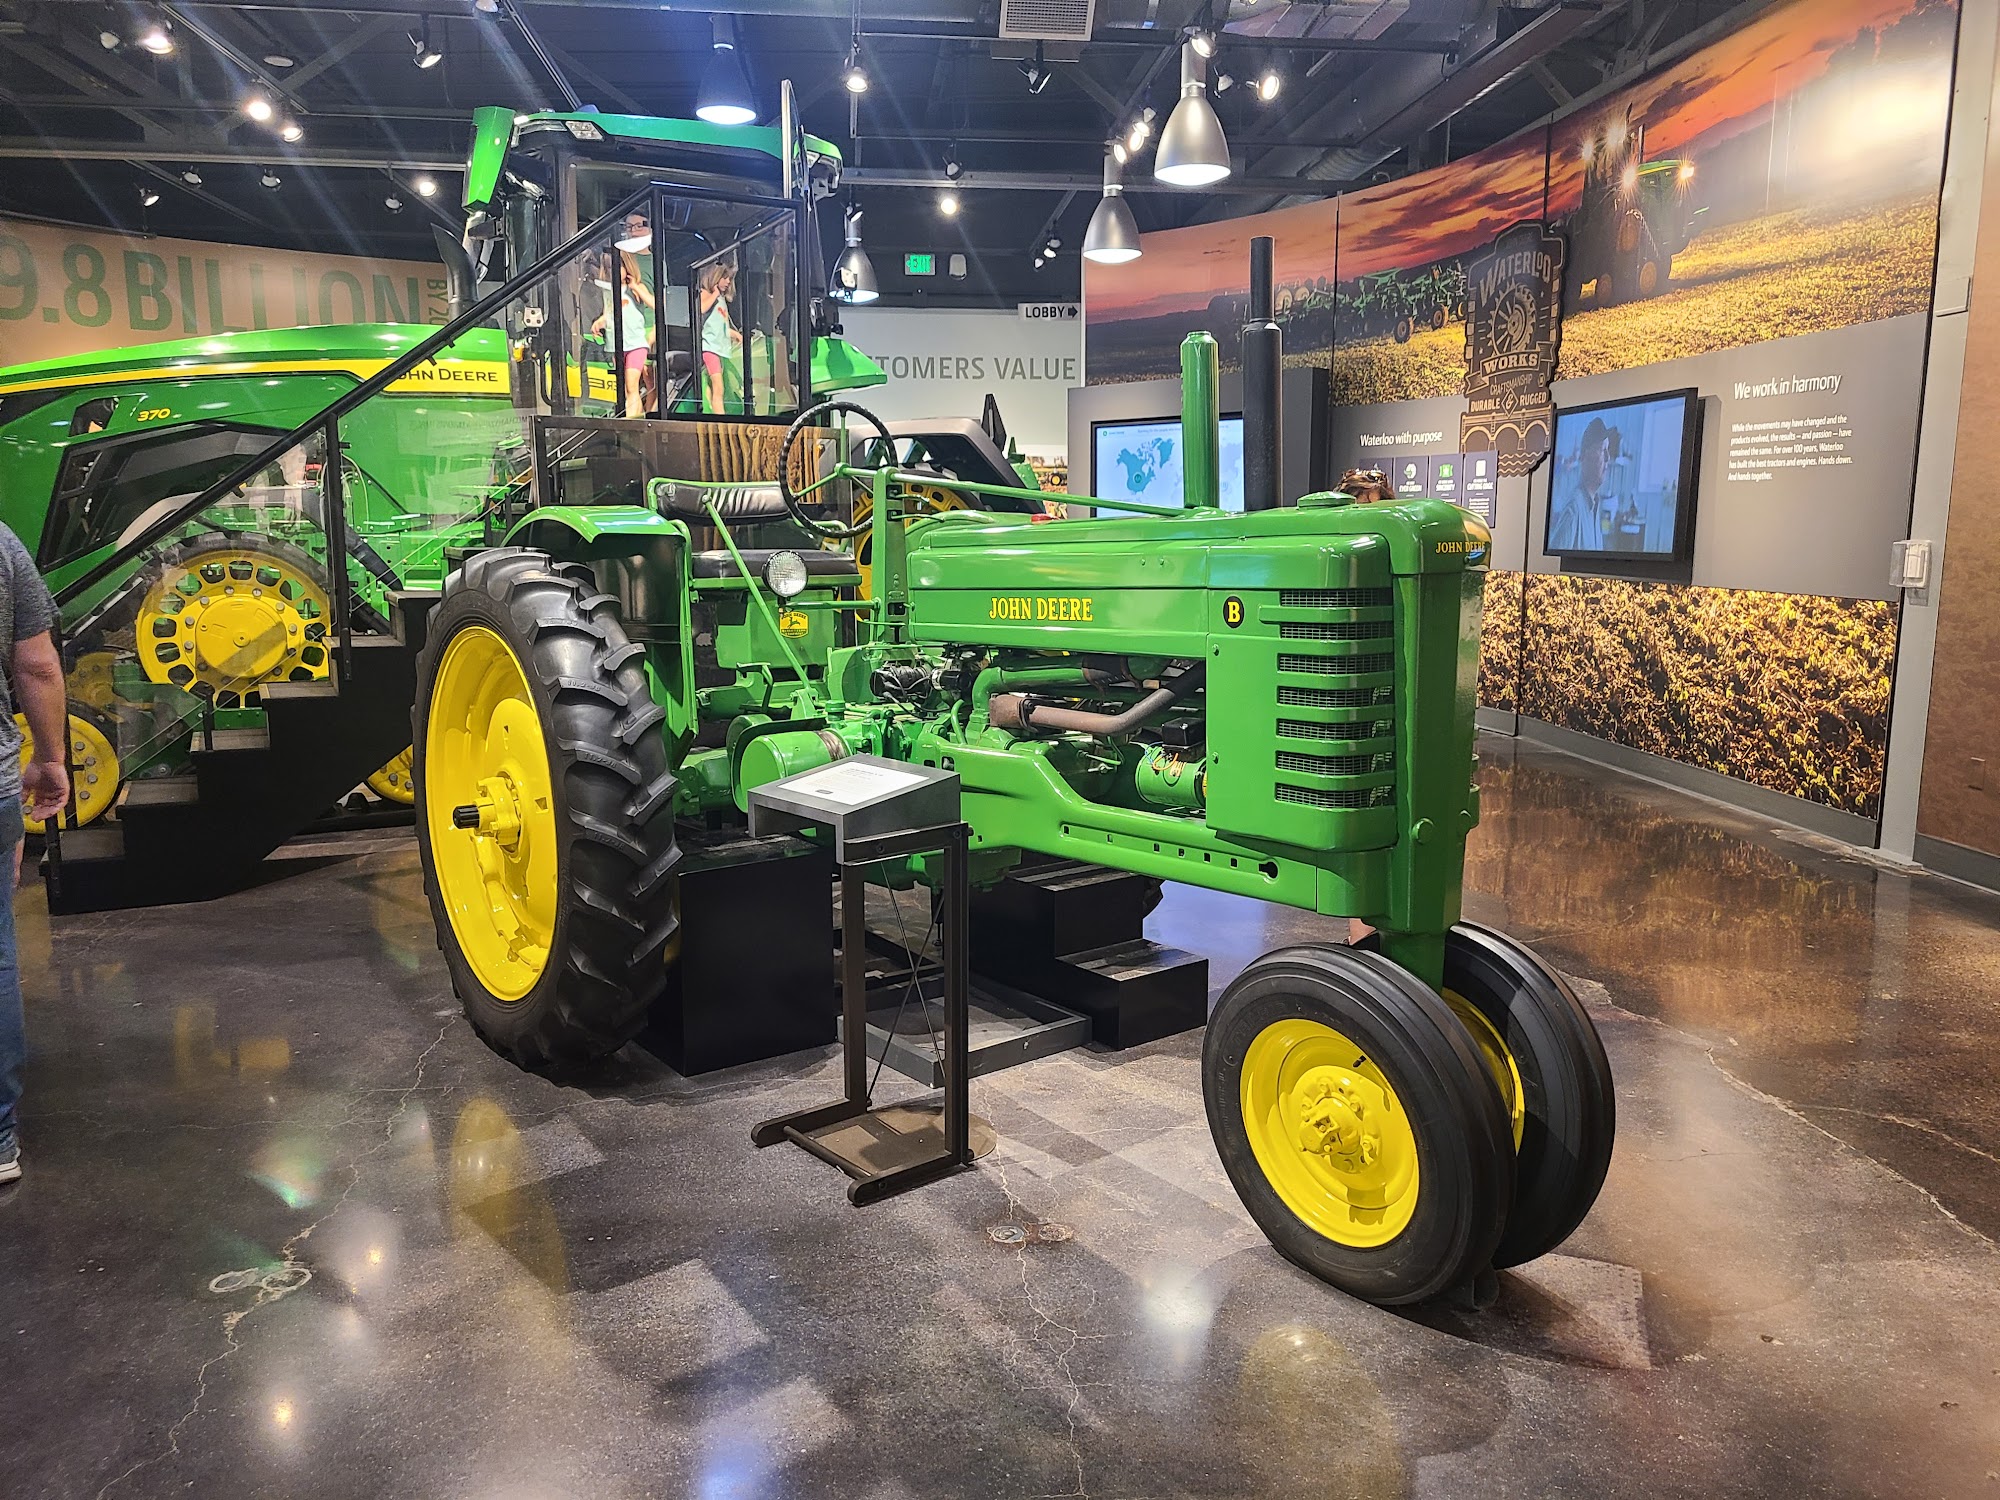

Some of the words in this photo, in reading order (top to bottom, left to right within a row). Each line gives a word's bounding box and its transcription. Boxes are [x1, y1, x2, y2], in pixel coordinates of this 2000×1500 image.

[909, 254, 932, 273] EXIT
[1480, 251, 1551, 308] WATERLOO
[123, 249, 421, 335] BILLION
[427, 278, 449, 304] BY
[1025, 306, 1065, 318] LOBBY
[867, 355, 985, 380] TOMERS
[993, 356, 1076, 381] VALUE
[1482, 353, 1539, 375] WORKS
[398, 368, 434, 381] OHN
[439, 368, 499, 382] DEERE
[1490, 373, 1533, 396] CRAFTSMANSHIP
[1734, 381, 1751, 400] We
[1752, 377, 1778, 398] work
[1779, 377, 1790, 395] in
[1791, 374, 1842, 395] harmony
[1470, 397, 1501, 413] DURABLE
[1520, 391, 1547, 407] RUGGED
[136, 407, 171, 422] 370
[1731, 423, 1744, 432] While
[1745, 422, 1753, 431] the
[1753, 420, 1780, 430] movements
[1780, 420, 1791, 430] may
[1792, 418, 1804, 428] have
[1804, 416, 1826, 428] changed
[1826, 414, 1838, 424] and
[1838, 414, 1848, 424] the
[1360, 432, 1394, 447] Waterloo
[1395, 430, 1412, 444] with
[1412, 430, 1443, 446] purpose
[1730, 436, 1750, 446] products
[1770, 432, 1779, 442] the
[1779, 432, 1796, 442] results
[1802, 430, 1812, 440] and
[1812, 430, 1832, 442] passion
[1838, 428, 1852, 438] have
[1730, 447, 1750, 456] remained
[1750, 446, 1758, 456] the
[1773, 445, 1782, 454] For
[1782, 446, 1794, 454] over
[1794, 444, 1803, 454] 100
[1818, 442, 1844, 452] Waterloo
[1728, 460, 1736, 468] has
[1736, 459, 1748, 468] built
[1748, 458, 1756, 468] the
[1756, 458, 1766, 468] best
[1766, 458, 1786, 468] tractors
[1786, 456, 1796, 466] and
[1796, 456, 1818, 468] engines.
[1818, 455, 1836, 466] Hands
[1836, 454, 1853, 465] down.
[1728, 472, 1738, 480] And
[1738, 471, 1750, 480] hands
[1750, 470, 1773, 482] together.
[1436, 542, 1463, 554] JOHN
[1465, 541, 1486, 553] DEERE
[989, 597, 1032, 620] JOHN
[1036, 597, 1094, 622] DEERE
[1226, 601, 1241, 623] B
